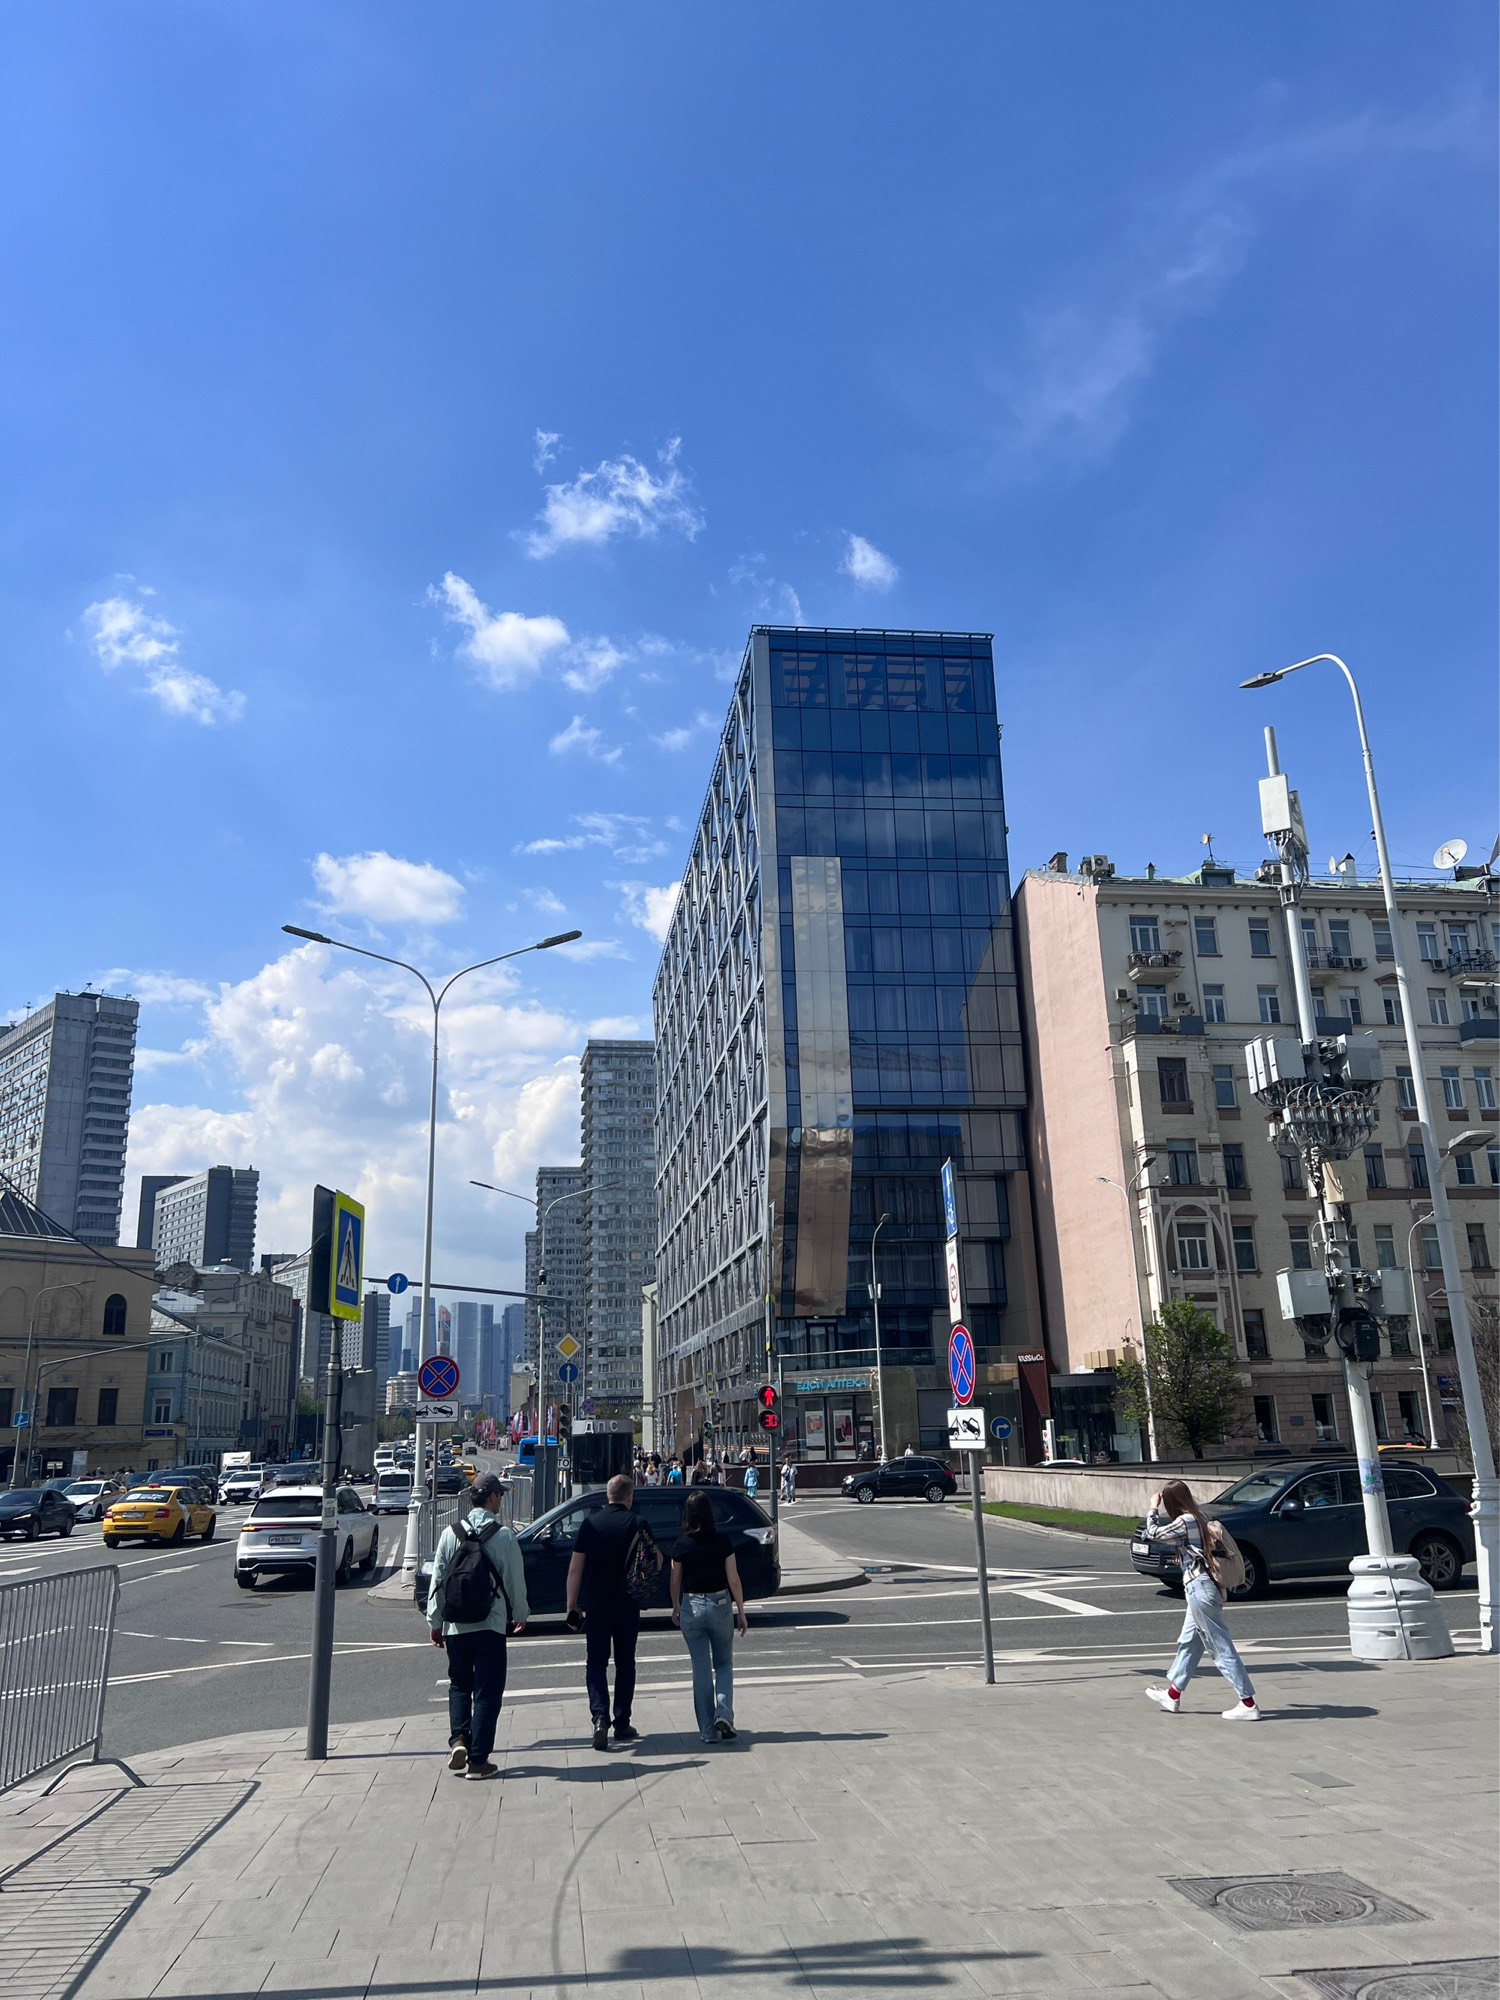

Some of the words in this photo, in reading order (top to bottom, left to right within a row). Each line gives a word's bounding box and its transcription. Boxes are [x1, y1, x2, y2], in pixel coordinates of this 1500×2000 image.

[796, 1380, 824, 1392] ЕДСИ
[826, 1378, 867, 1390] АПТЕКА
[584, 1420, 618, 1434] ДПС
[764, 1413, 778, 1427] 30
